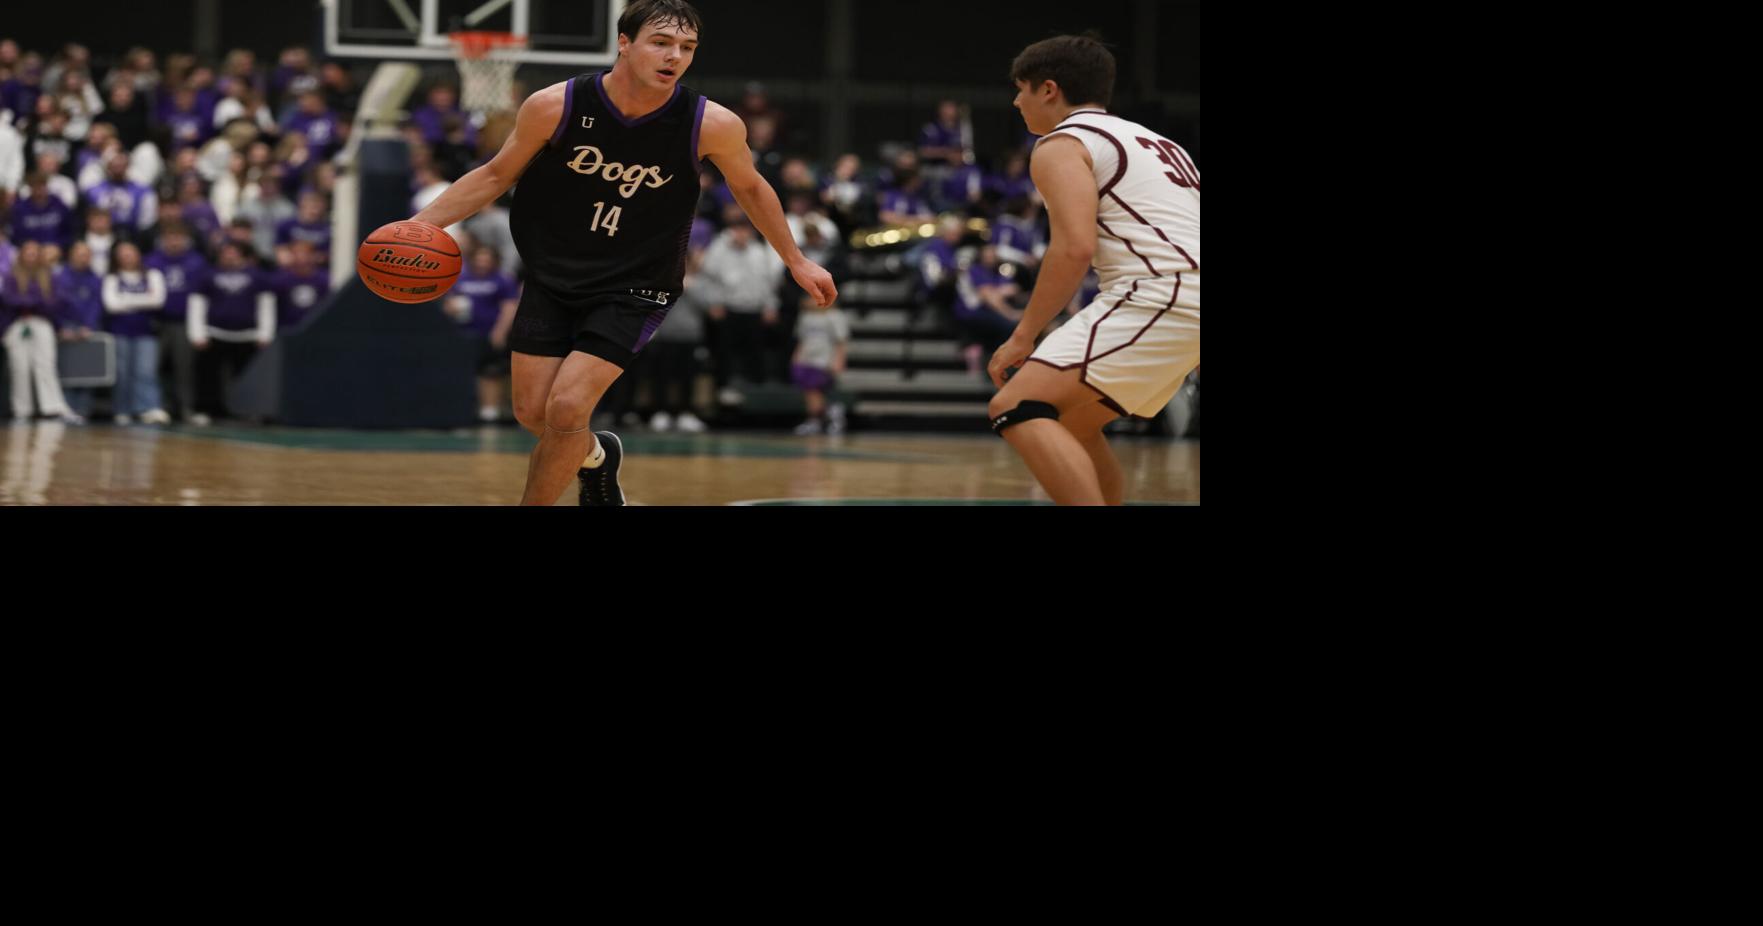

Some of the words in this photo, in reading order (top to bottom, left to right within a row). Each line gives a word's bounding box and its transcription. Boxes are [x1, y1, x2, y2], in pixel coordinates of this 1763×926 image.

[567, 145, 673, 198] Dogs
[1135, 136, 1200, 192] 30
[590, 201, 622, 236] 14
[373, 248, 441, 270] Baden
